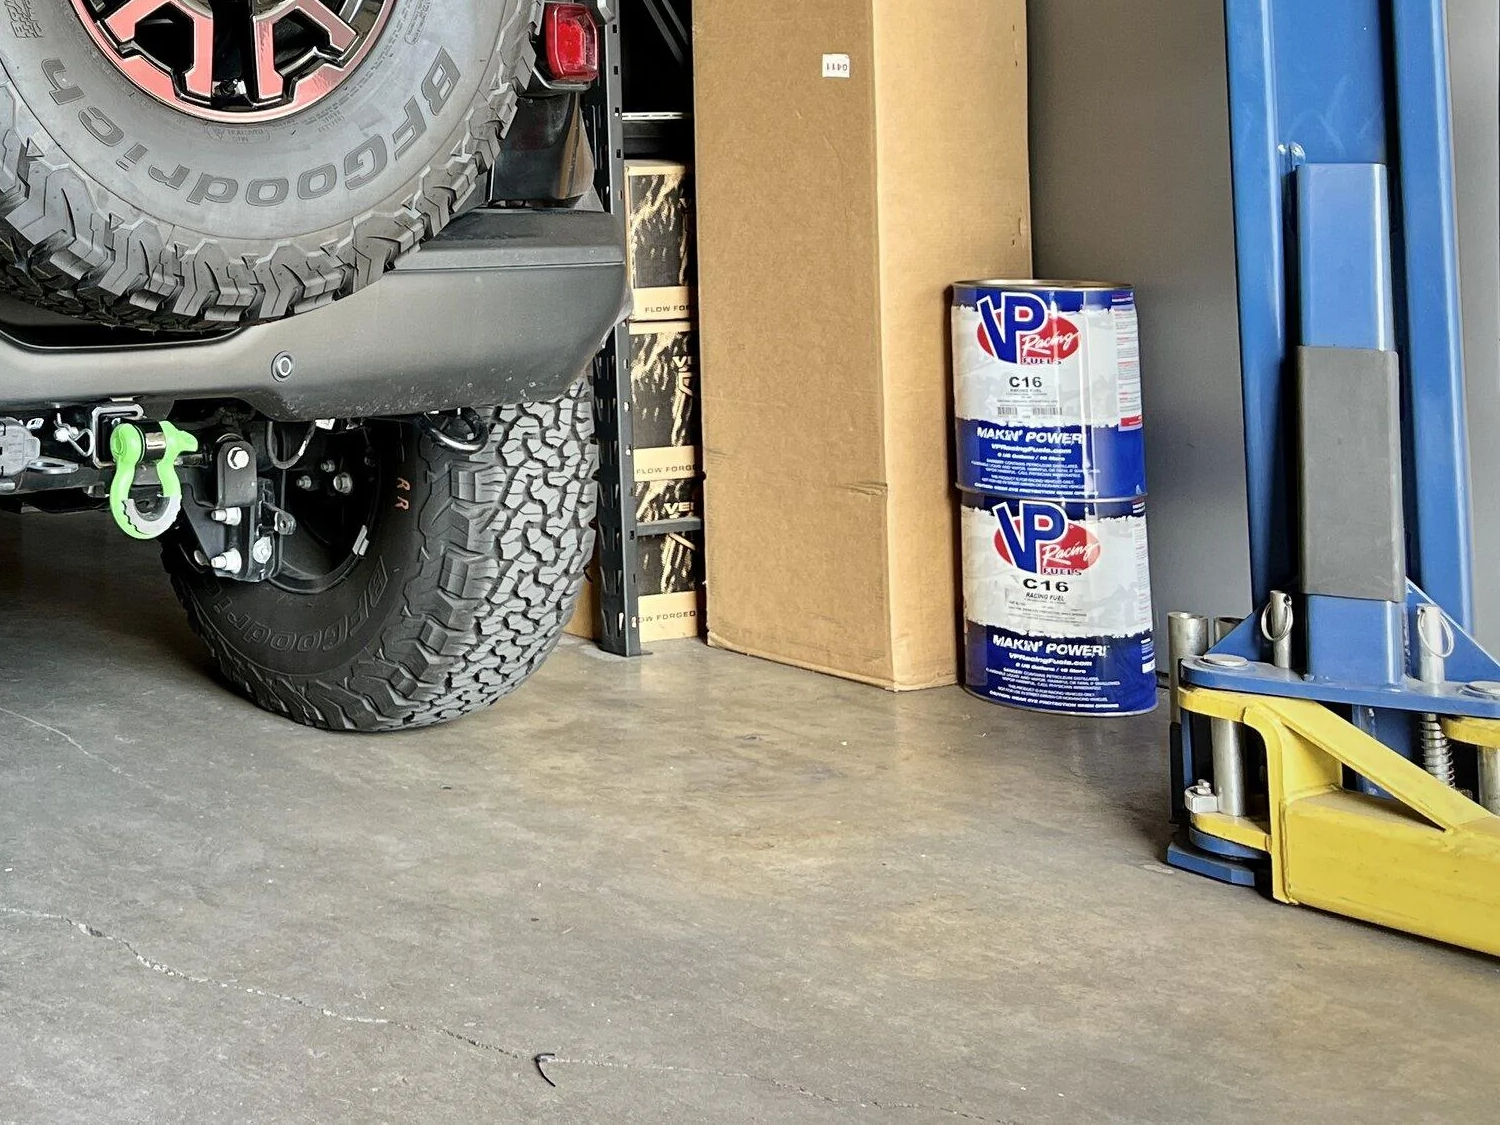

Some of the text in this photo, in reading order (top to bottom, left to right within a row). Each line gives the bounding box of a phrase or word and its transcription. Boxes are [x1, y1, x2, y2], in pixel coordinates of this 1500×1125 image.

[41, 46, 461, 206] BFGoodrich
[645, 306, 670, 314] FLOW
[977, 291, 1049, 365] VP
[1021, 330, 1082, 355] Racing
[1009, 375, 1043, 389] C16
[992, 500, 1069, 574] VP
[1041, 541, 1100, 566] Racing
[1022, 578, 1070, 593] C16
[1025, 592, 1065, 602] RACING FUEL
[656, 610, 696, 621] FORGED
[992, 634, 1044, 653] MAKIN'
